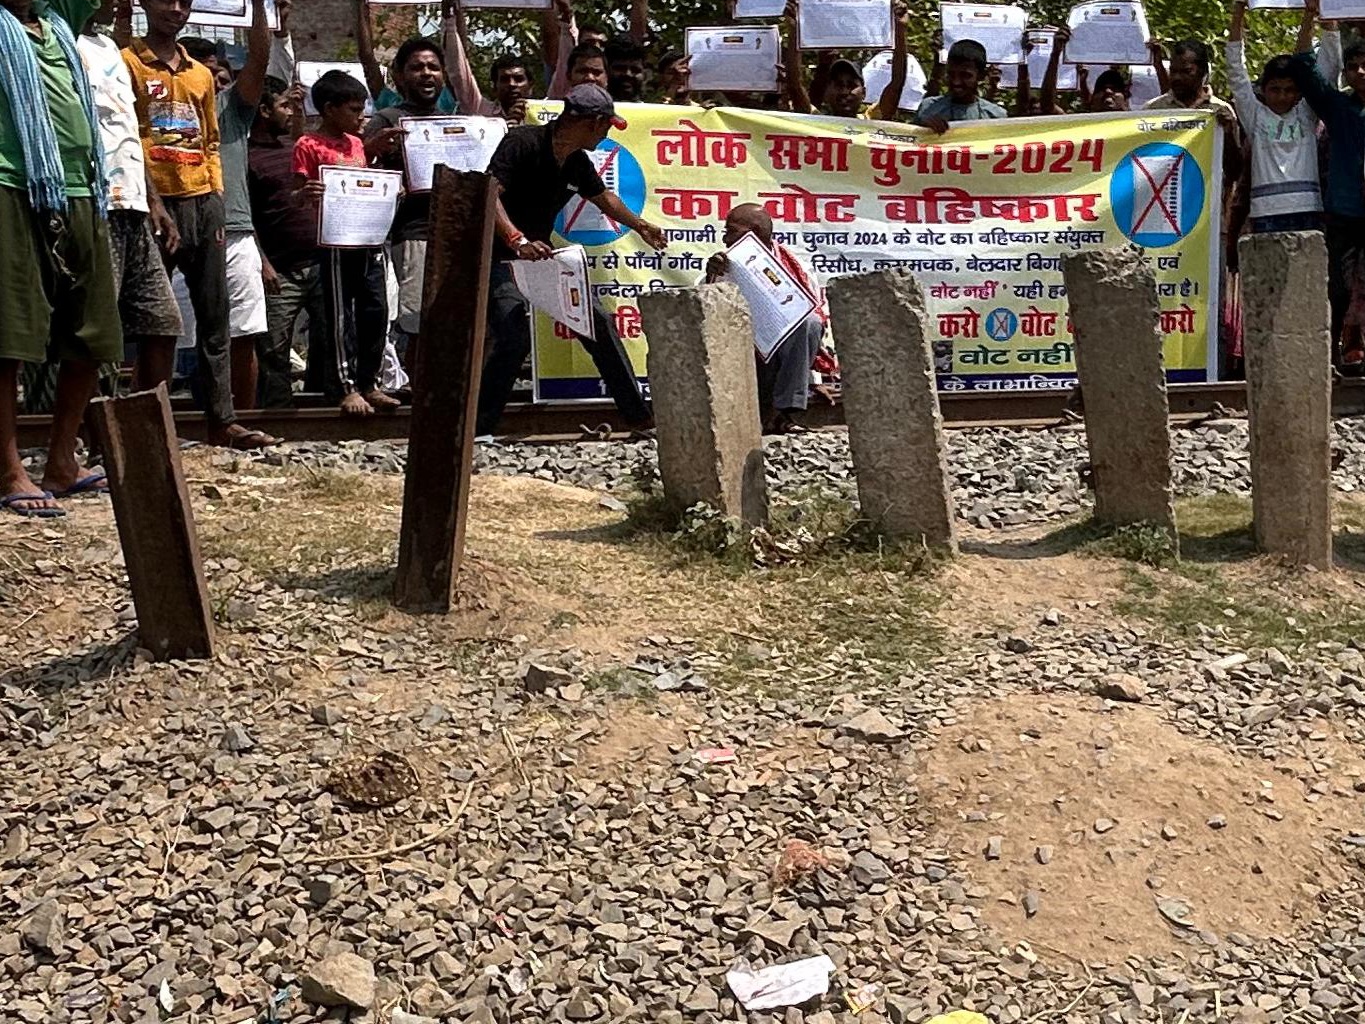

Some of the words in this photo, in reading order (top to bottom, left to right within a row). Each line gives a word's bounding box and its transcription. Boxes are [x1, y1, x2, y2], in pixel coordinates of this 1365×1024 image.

[651, 119, 751, 168] लोक
[765, 134, 852, 172] सभा
[868, 138, 1104, 187] चुनाव-2024
[654, 188, 739, 221] का
[757, 183, 860, 223] वोट
[877, 186, 1102, 225] बहिष्कार
[802, 231, 850, 252] चुनाव
[854, 231, 888, 246] 2024
[892, 227, 911, 245] के
[916, 227, 946, 246] वोट
[949, 231, 973, 245] का
[1054, 226, 1105, 250] संयुक्त
[601, 249, 620, 269] से
[667, 251, 704, 271] गाँव
[1157, 251, 1183, 271] एवं
[930, 280, 960, 299] वोट
[963, 280, 999, 300] नहीं
[1013, 280, 1044, 299] यही
[937, 306, 981, 339] करो
[1019, 306, 1058, 337] वोट
[1160, 303, 1196, 334] करो
[958, 344, 1011, 367] वोट
[942, 376, 967, 392] के
